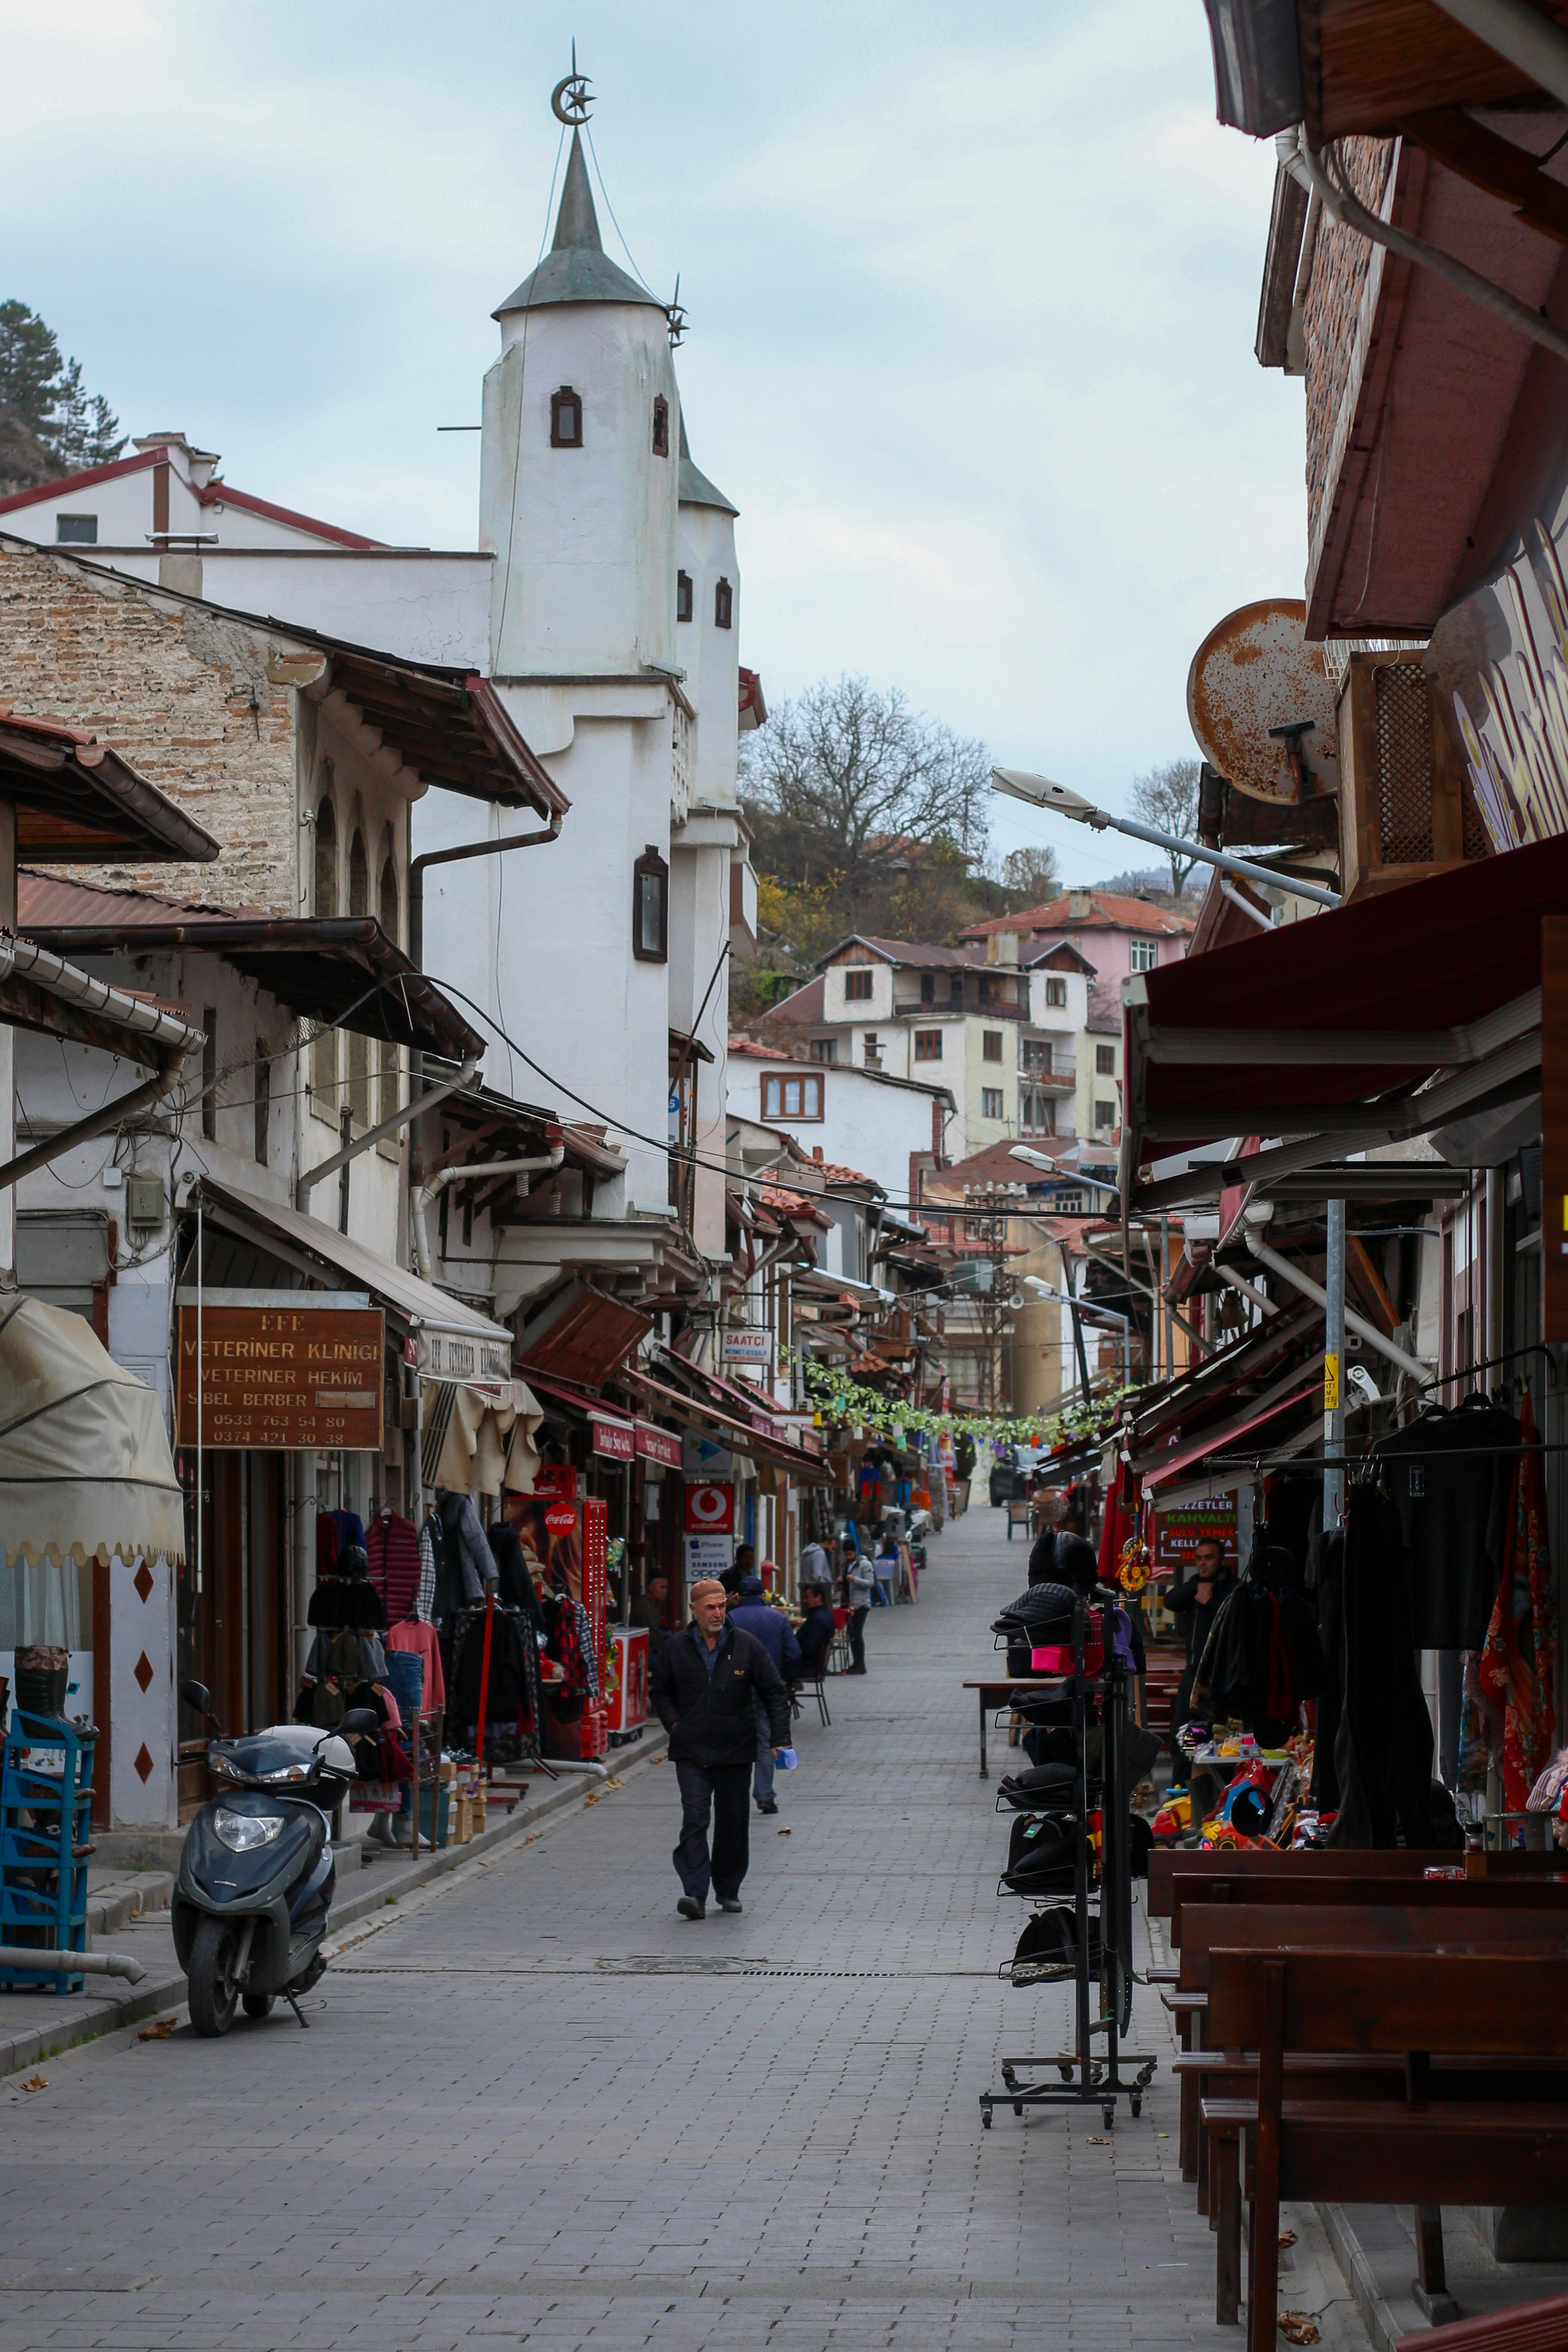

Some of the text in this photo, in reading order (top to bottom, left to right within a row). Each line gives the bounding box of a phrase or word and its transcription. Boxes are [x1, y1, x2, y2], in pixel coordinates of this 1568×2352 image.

[262, 1315, 304, 1331] EFE
[184, 1337, 294, 1358] VETERİNER
[432, 1339, 441, 1369] EFE
[201, 1365, 362, 1385] VETERİNER HEKİM
[188, 1393, 306, 1407] SBEL BERBER
[214, 1414, 345, 1427] 0533 763 54 80
[214, 1431, 344, 1445] 0374 421 30 38
[1166, 1513, 1236, 1523] KAHVALTI
[1169, 1528, 1234, 1536] SULU YEMEK
